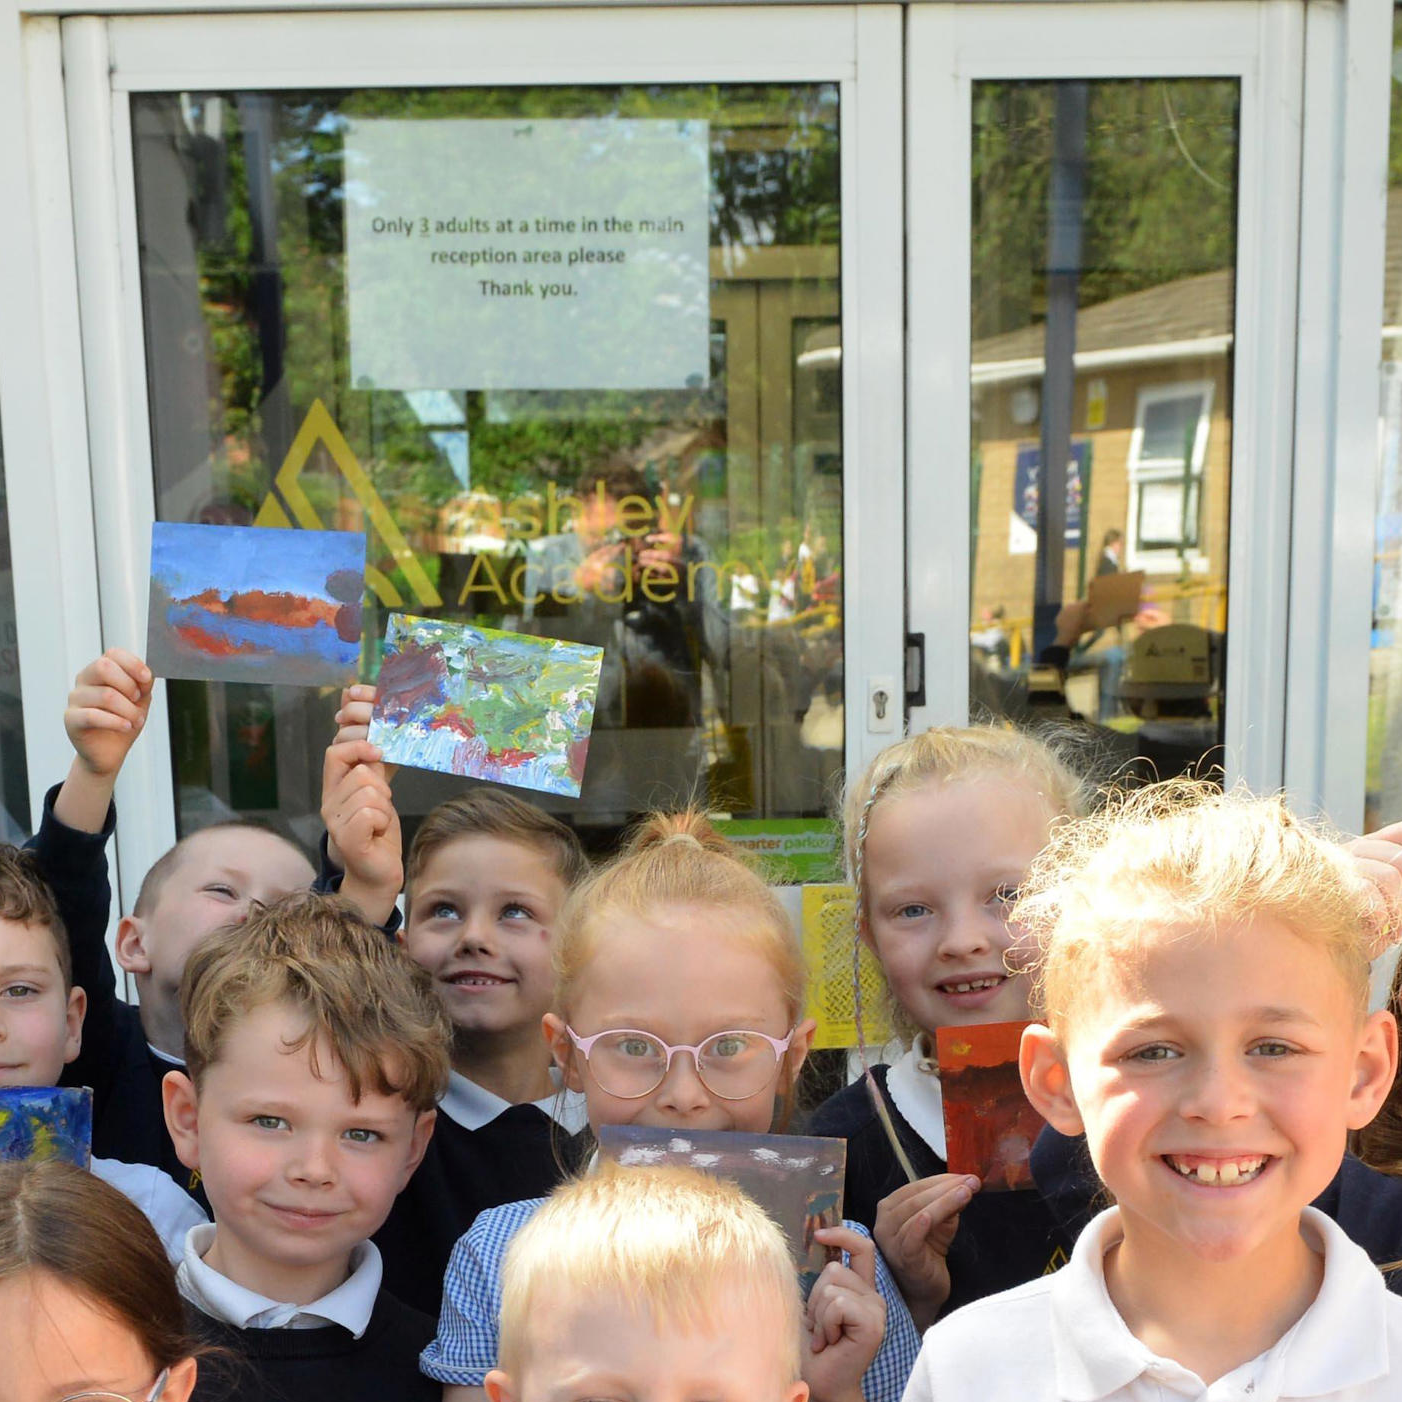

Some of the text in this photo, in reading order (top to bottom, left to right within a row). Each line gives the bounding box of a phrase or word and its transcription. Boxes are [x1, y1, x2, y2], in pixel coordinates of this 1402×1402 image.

[371, 216, 684, 237] Only 3 adults at a time in the main
[430, 246, 626, 267] reception area please
[478, 280, 578, 300] Thank you.
[459, 479, 695, 549] Ashley
[458, 546, 797, 615] Academy
